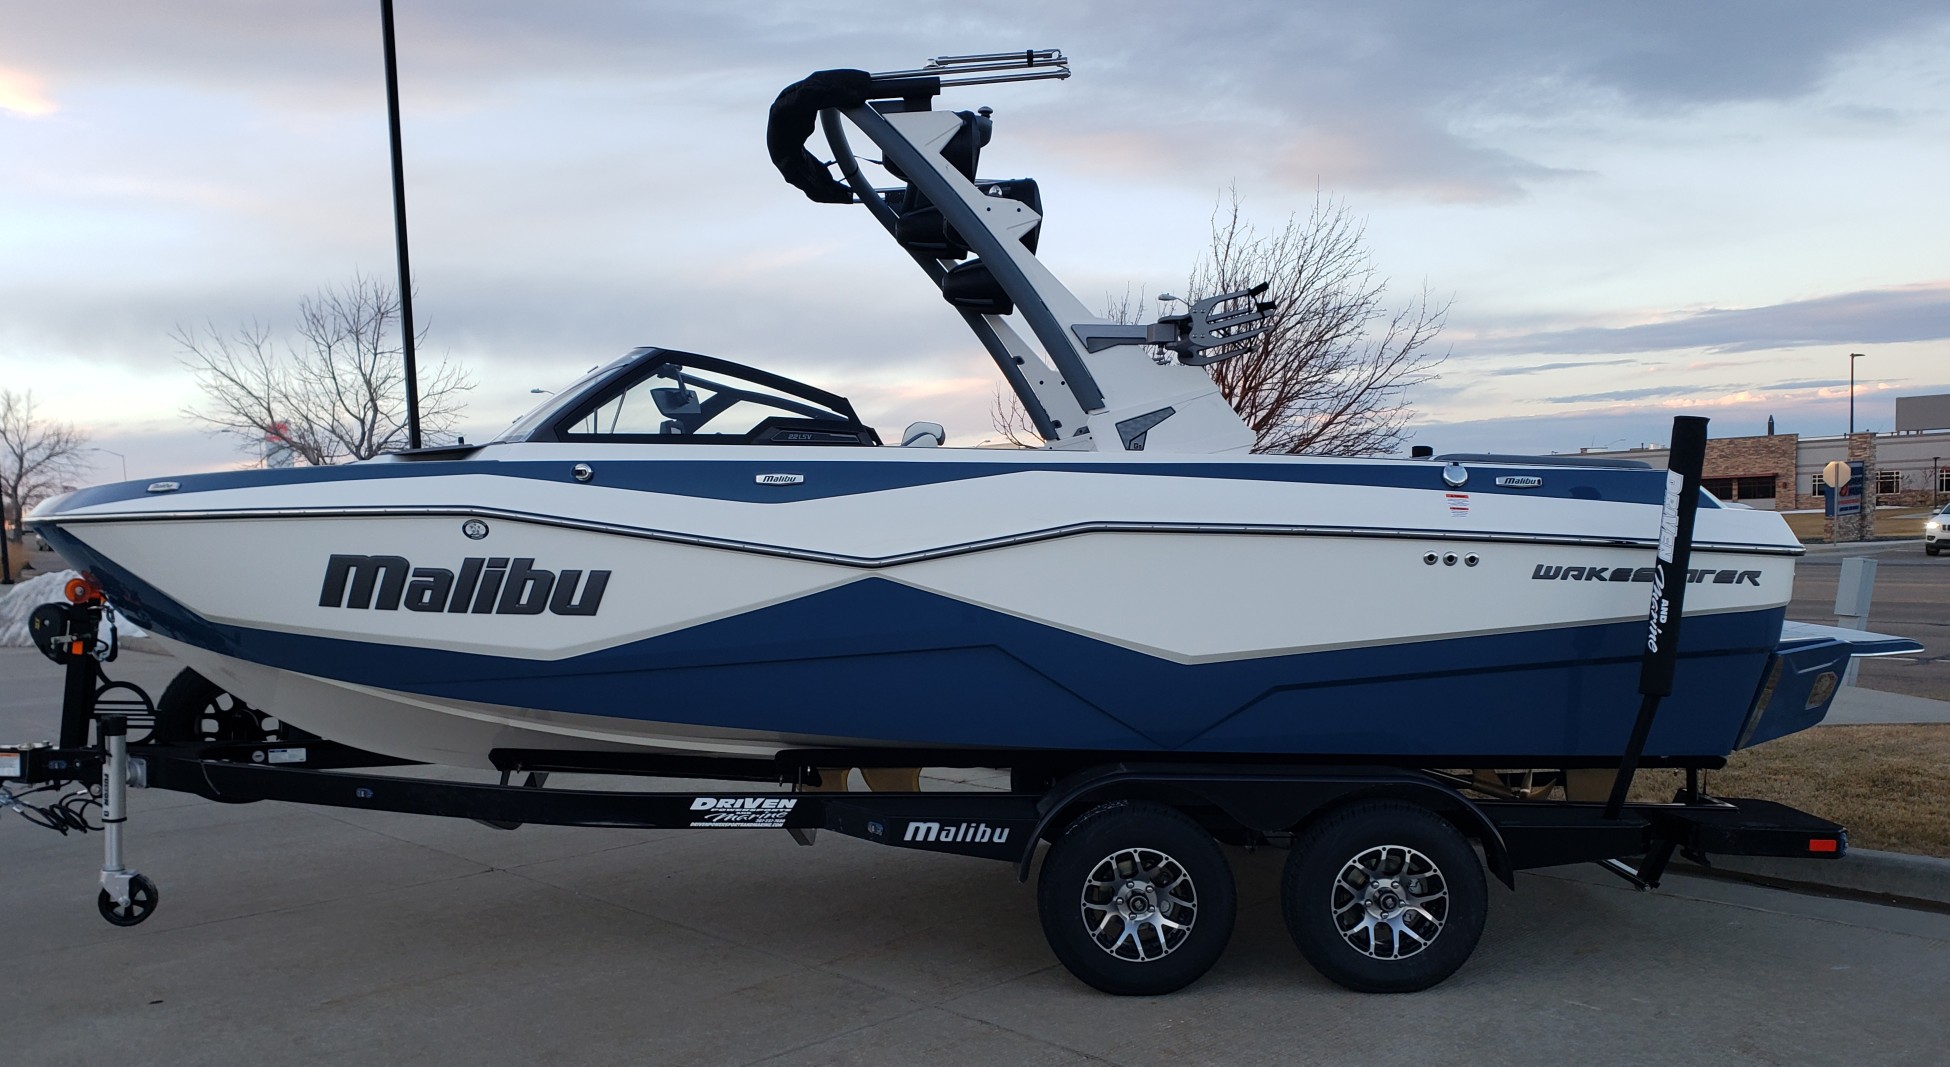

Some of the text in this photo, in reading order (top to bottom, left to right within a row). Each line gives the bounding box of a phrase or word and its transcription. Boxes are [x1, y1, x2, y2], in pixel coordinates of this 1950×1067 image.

[762, 475, 797, 483] Malibu
[1504, 477, 1538, 485] Malibu
[1647, 564, 1665, 653] Marine
[1659, 598, 1669, 624] AND
